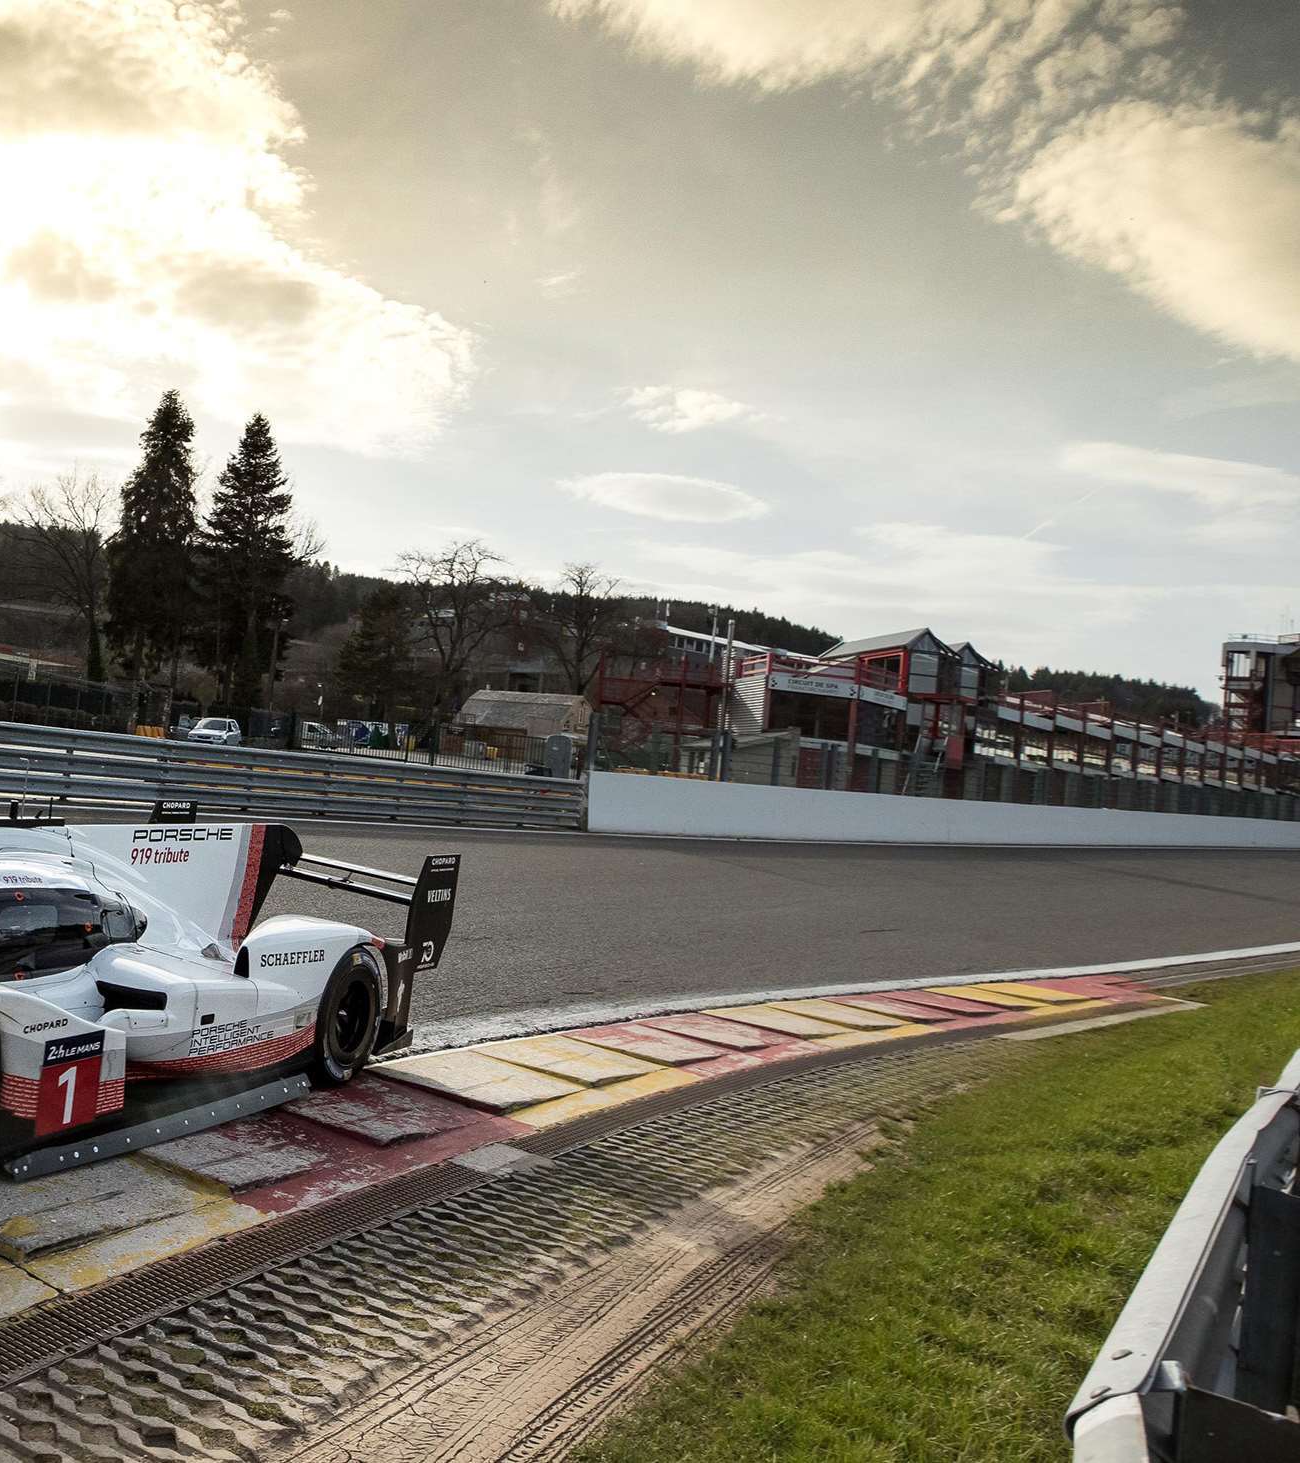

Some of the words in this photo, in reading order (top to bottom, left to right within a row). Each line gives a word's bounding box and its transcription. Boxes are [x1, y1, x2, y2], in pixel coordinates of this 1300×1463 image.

[162, 801, 191, 809] CHOPARD
[132, 828, 234, 842] PORSCHE
[131, 848, 153, 865] 919
[154, 847, 190, 864] tribute
[431, 857, 456, 866] CHOPARD
[2, 875, 18, 885] 919
[19, 875, 43, 885] tribute
[427, 888, 452, 903] VELTINS
[260, 949, 325, 968] SCHAEFFLER
[23, 1018, 69, 1034] CHOPARD
[191, 1019, 248, 1039] PORSCHE
[187, 1030, 275, 1057] PERFORMANCE
[189, 1025, 262, 1048] INTELLIGENT
[58, 1065, 78, 1125] 1
